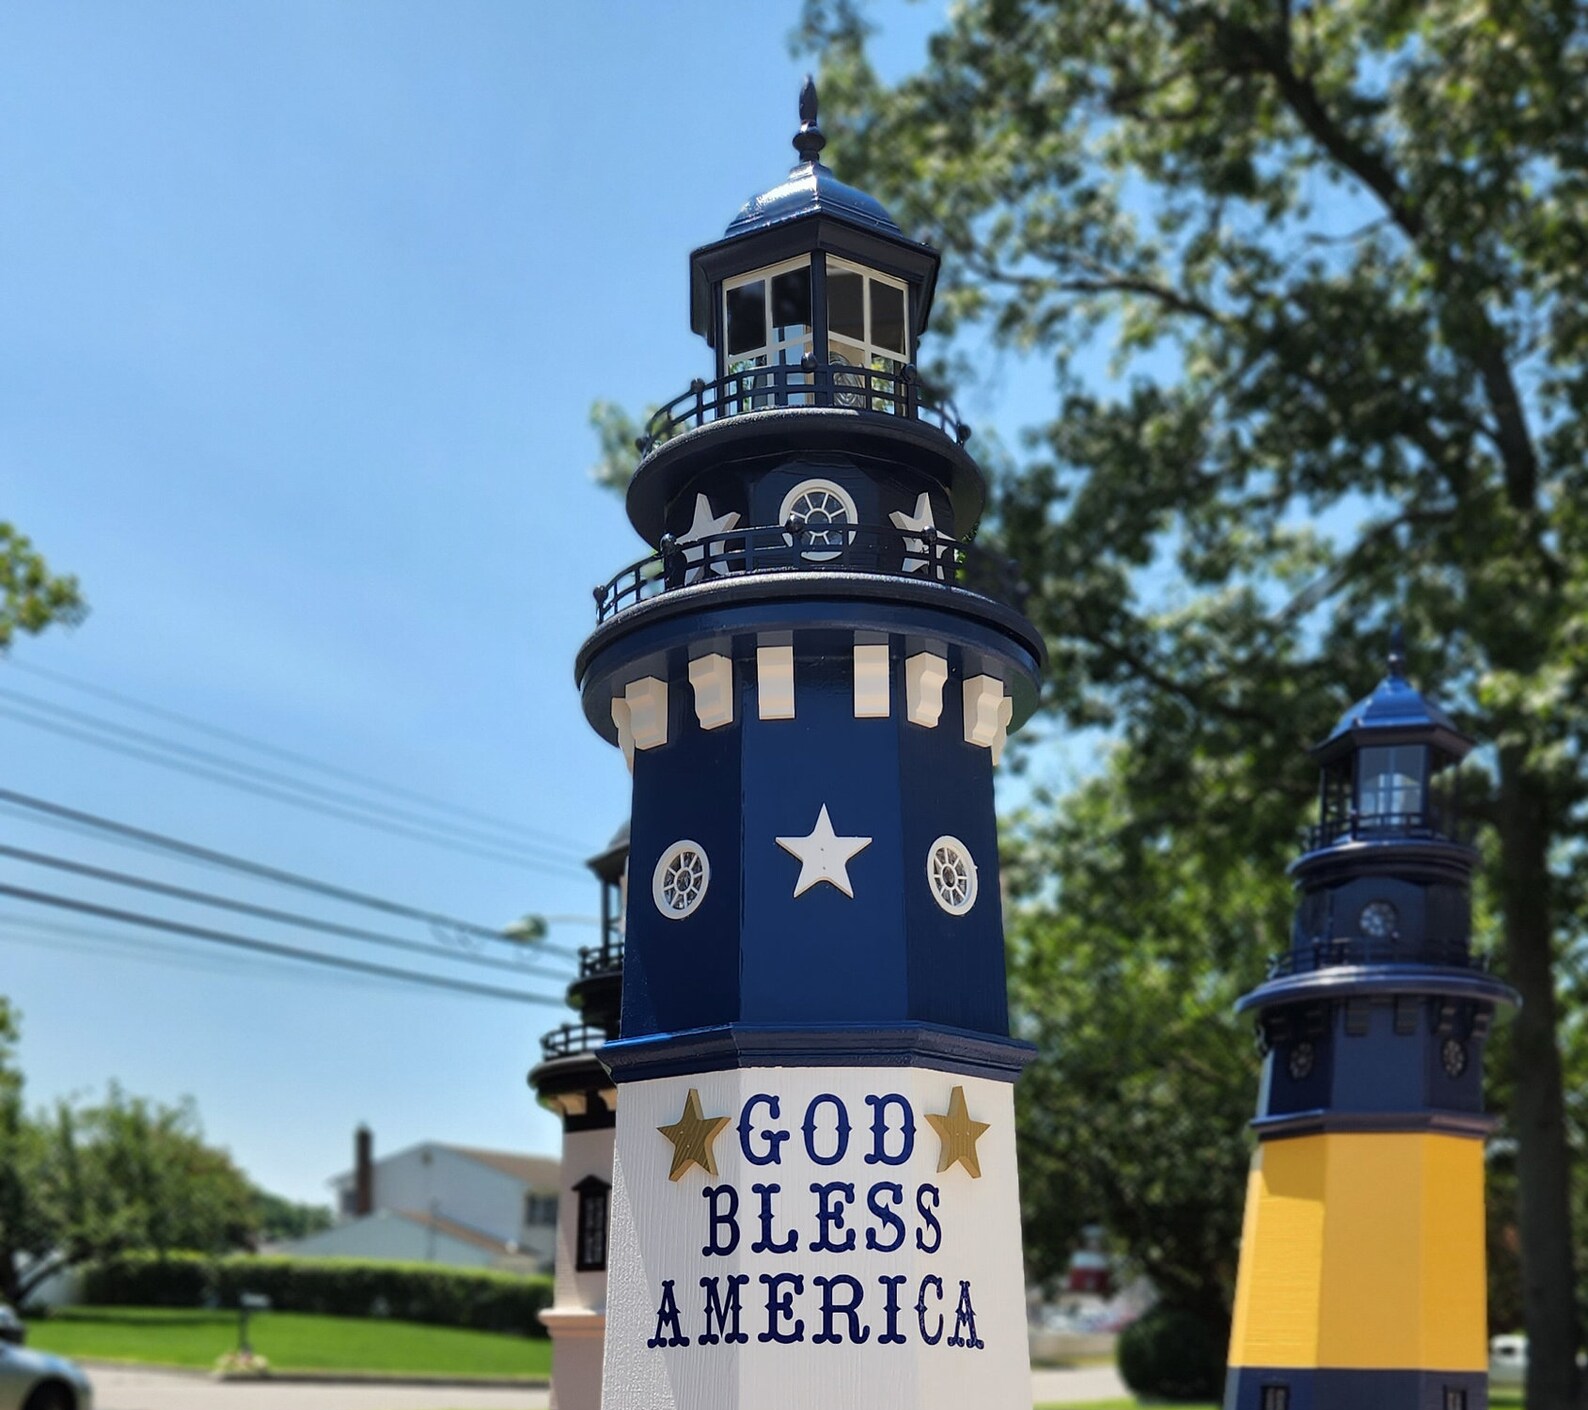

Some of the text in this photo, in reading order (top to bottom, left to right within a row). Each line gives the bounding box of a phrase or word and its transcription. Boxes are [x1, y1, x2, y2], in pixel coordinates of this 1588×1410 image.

[736, 1093, 917, 1166] GOD
[703, 1181, 942, 1256] BLESS
[648, 1273, 984, 1349] AMERICA
